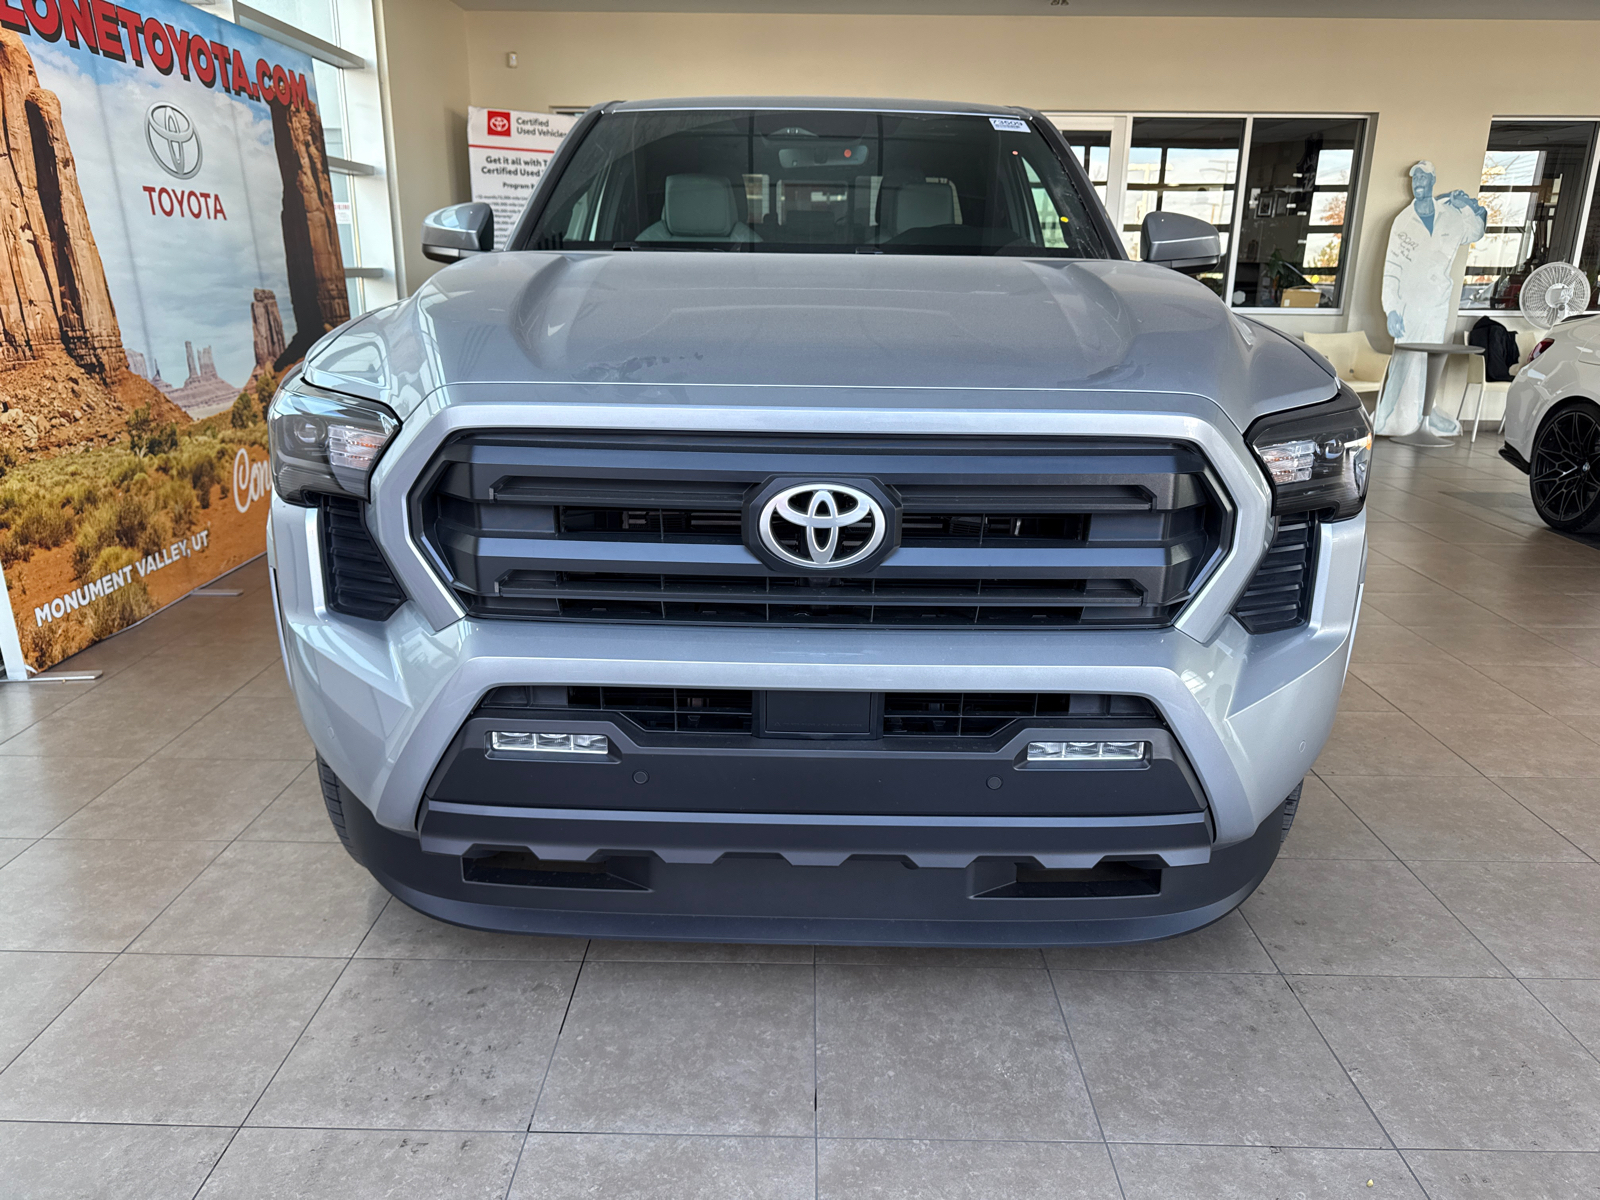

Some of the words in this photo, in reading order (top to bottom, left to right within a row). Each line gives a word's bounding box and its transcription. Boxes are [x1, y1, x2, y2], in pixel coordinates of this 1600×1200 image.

[516, 117, 549, 127] Certified
[517, 127, 536, 135] Used
[485, 155, 501, 164] Get
[503, 156, 509, 164] it
[511, 157, 521, 165] all
[523, 158, 542, 166] with
[481, 166, 518, 175] Certified
[520, 168, 540, 177] Used
[503, 182, 529, 190] Program
[143, 186, 227, 221] TOYOTA
[34, 564, 133, 627] MONUMENT
[136, 539, 191, 577] VALLEY,
[191, 530, 209, 552] UT
